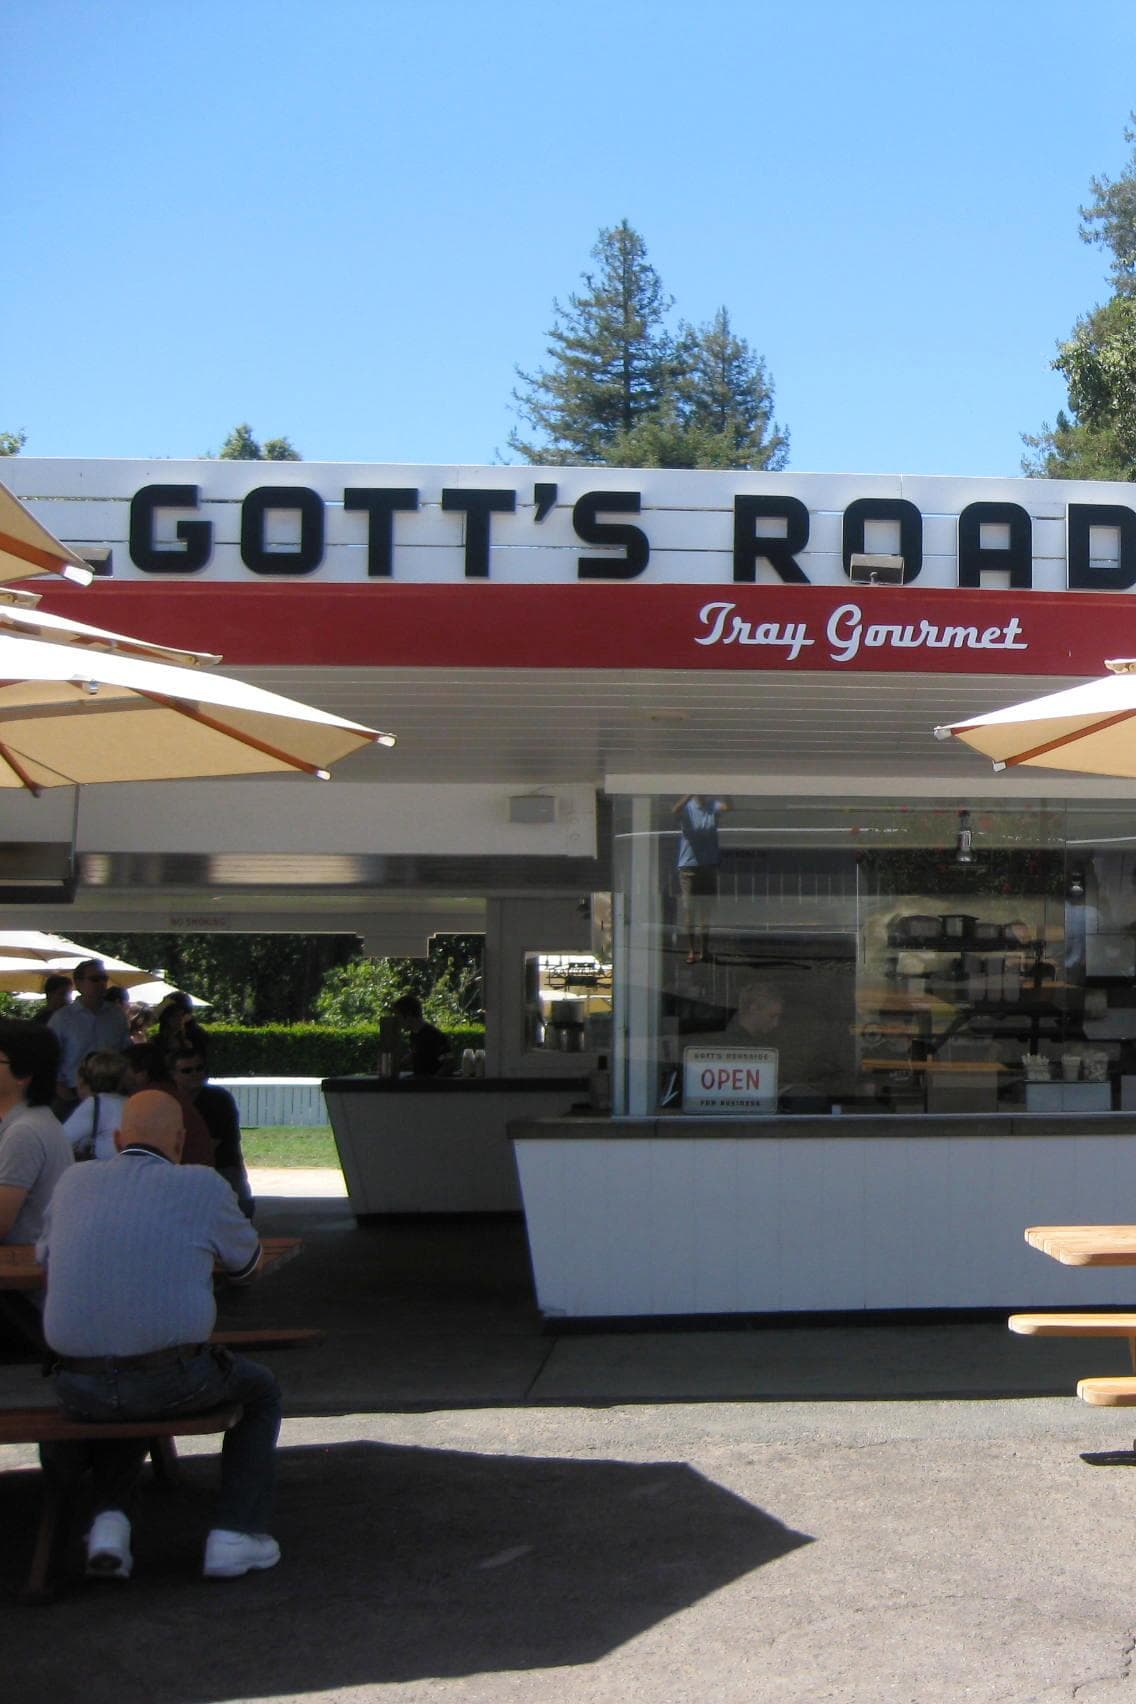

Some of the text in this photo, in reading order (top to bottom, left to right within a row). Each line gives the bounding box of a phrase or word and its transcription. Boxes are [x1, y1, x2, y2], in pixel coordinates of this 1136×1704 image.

[129, 483, 651, 580] GOTT'S
[694, 602, 1028, 662] Tray Gourmet
[701, 1068, 761, 1091] OPEN
